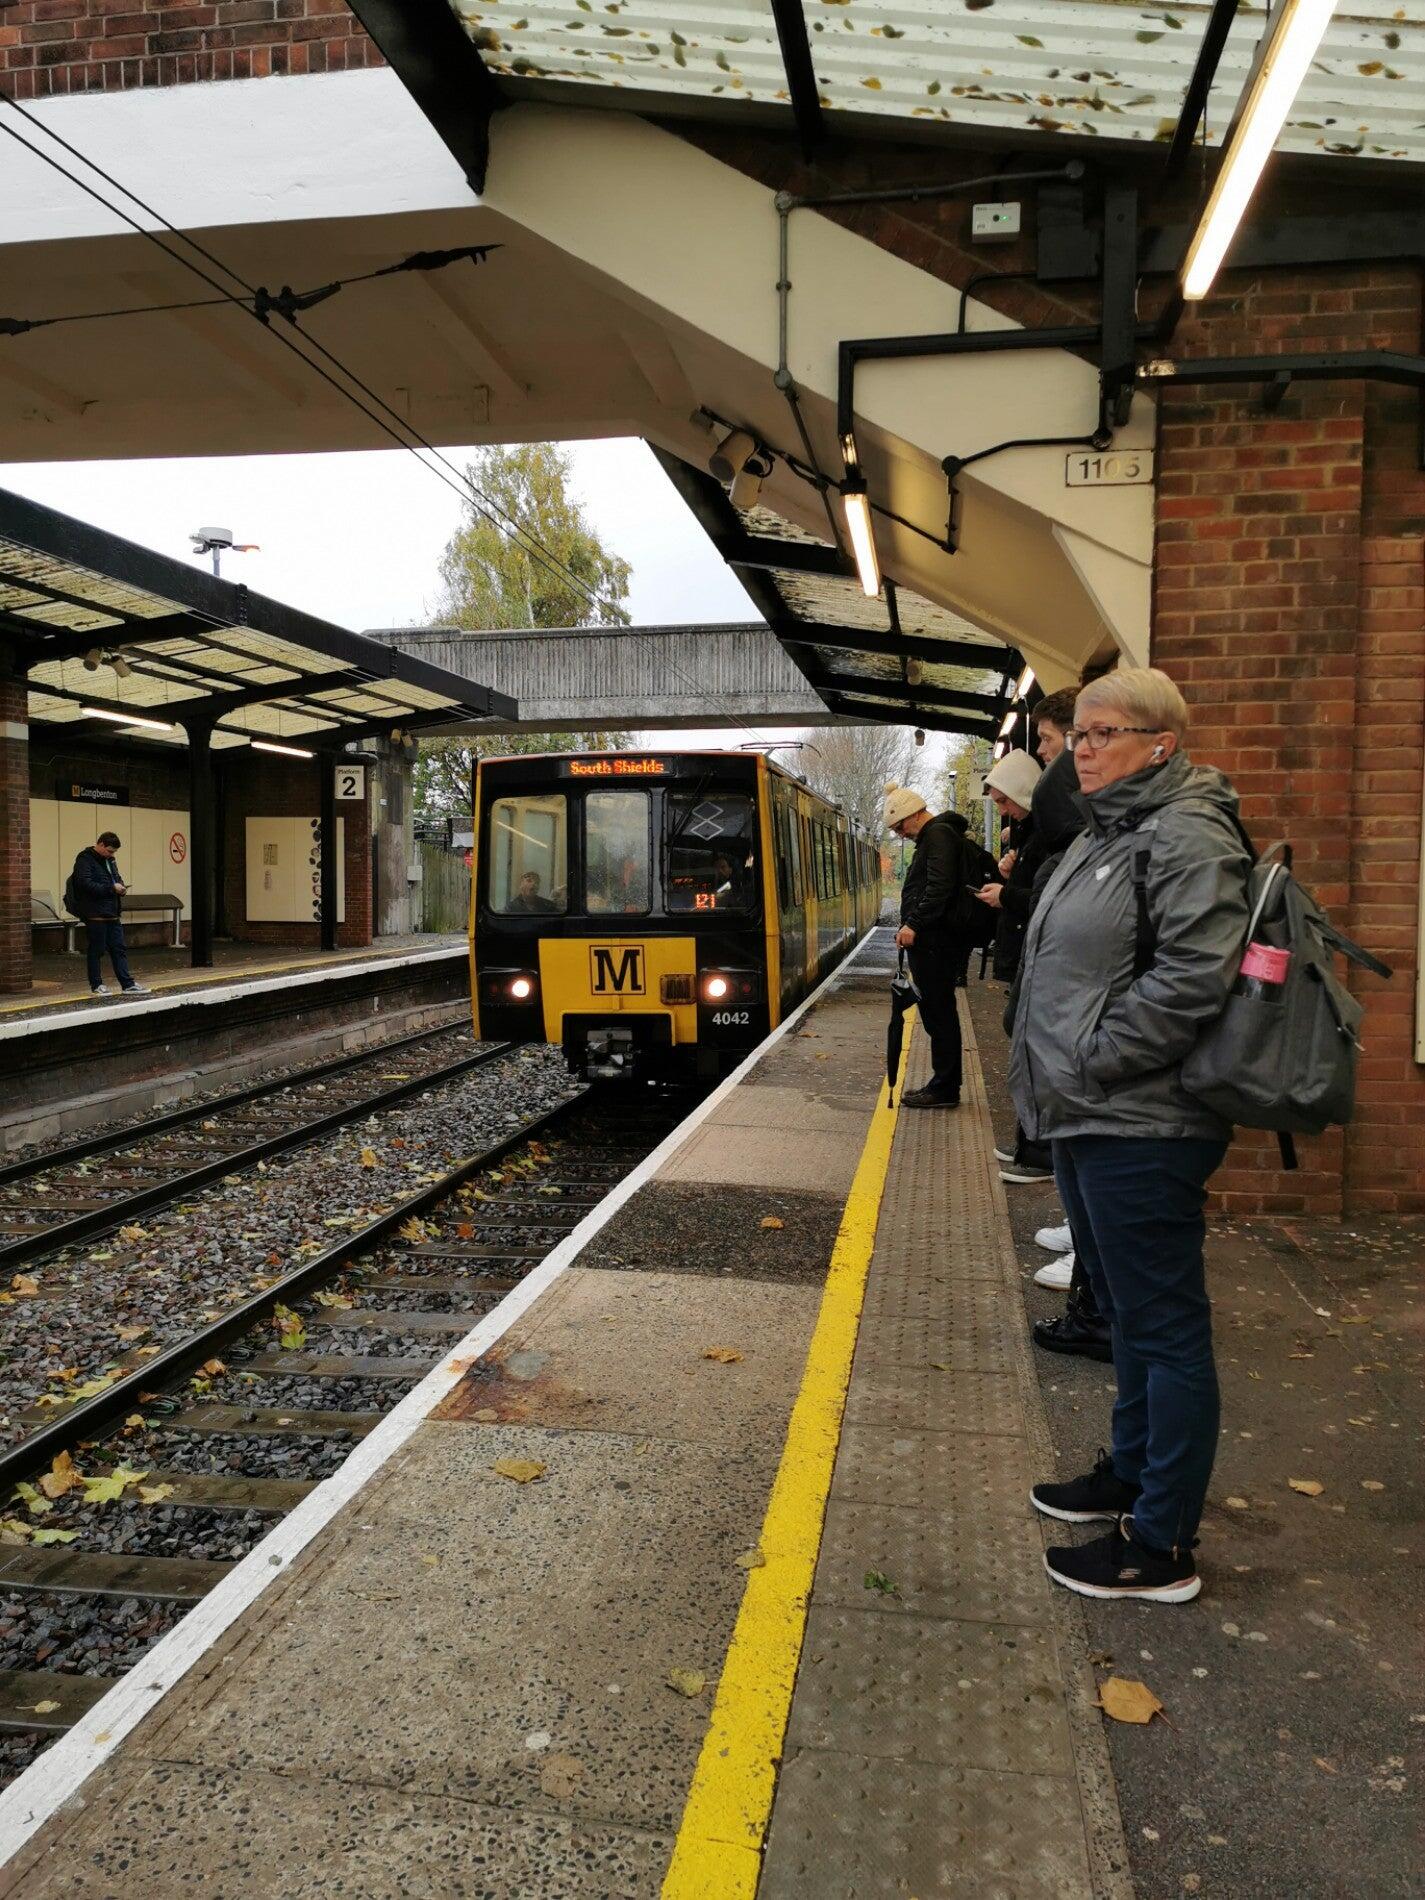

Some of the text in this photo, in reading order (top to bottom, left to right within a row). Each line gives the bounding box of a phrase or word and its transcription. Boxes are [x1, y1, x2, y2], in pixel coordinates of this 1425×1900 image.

[1079, 457, 1140, 479] 1105
[570, 759, 664, 774] South Shields
[81, 786, 118, 799] Longbenton
[342, 776, 356, 796] 2
[593, 949, 642, 991] M
[712, 1012, 749, 1025] 4042
